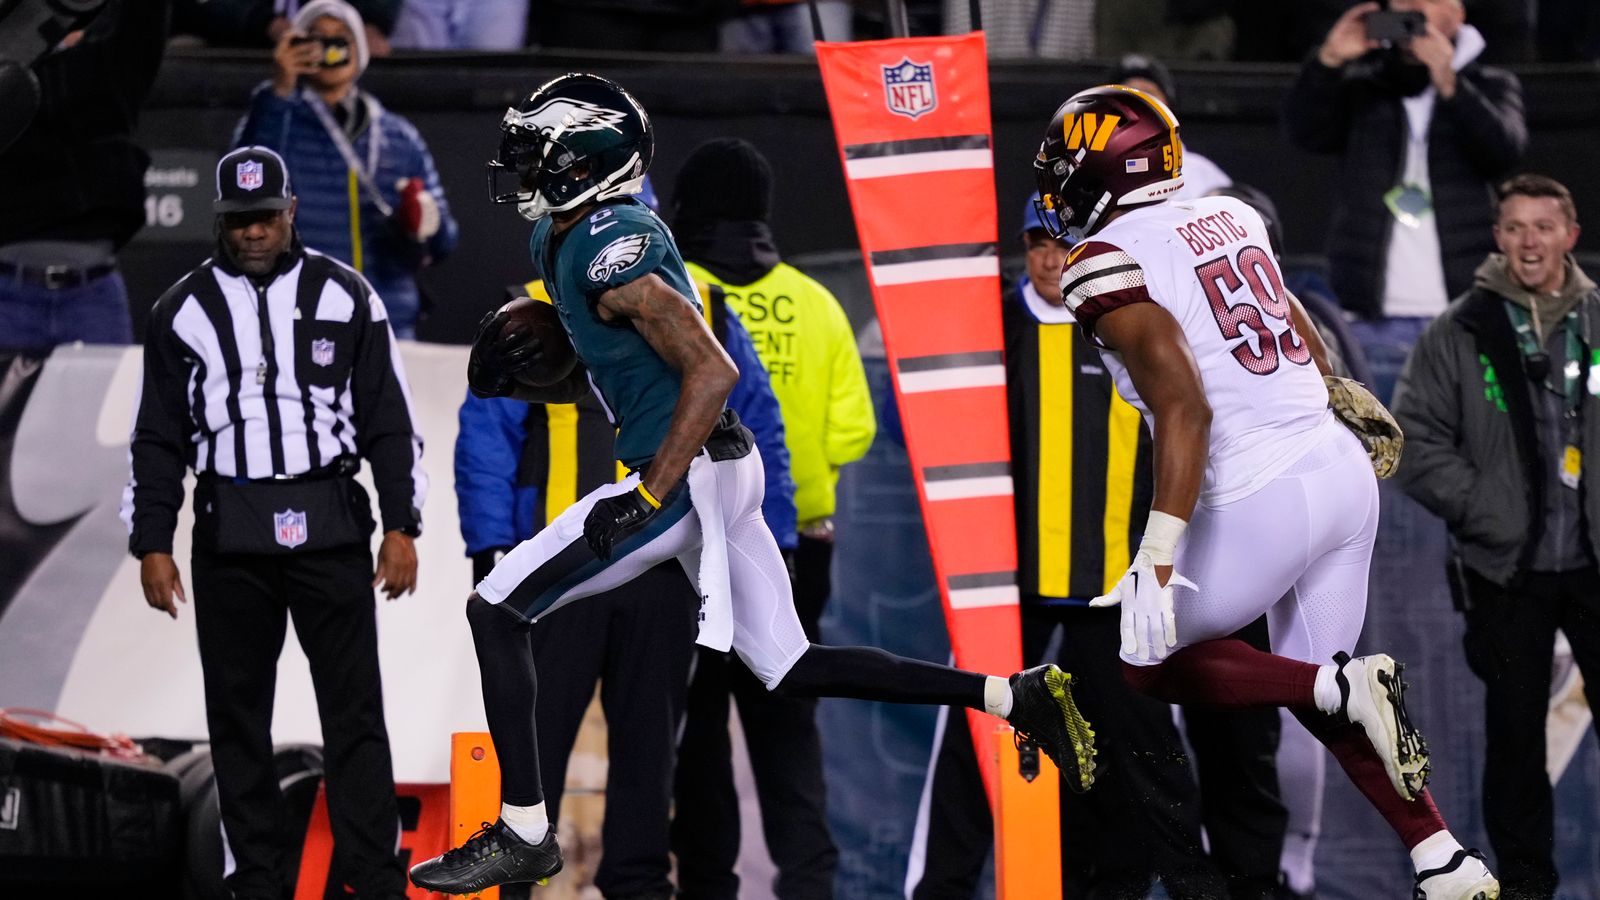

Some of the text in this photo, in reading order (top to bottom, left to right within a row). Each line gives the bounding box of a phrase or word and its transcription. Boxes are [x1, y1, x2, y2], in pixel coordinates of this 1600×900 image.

[891, 85, 931, 111] NFL
[1176, 210, 1248, 257] BOSTIC
[1194, 245, 1313, 376] 59
[750, 330, 796, 356] ENT
[279, 526, 304, 542] NFL
